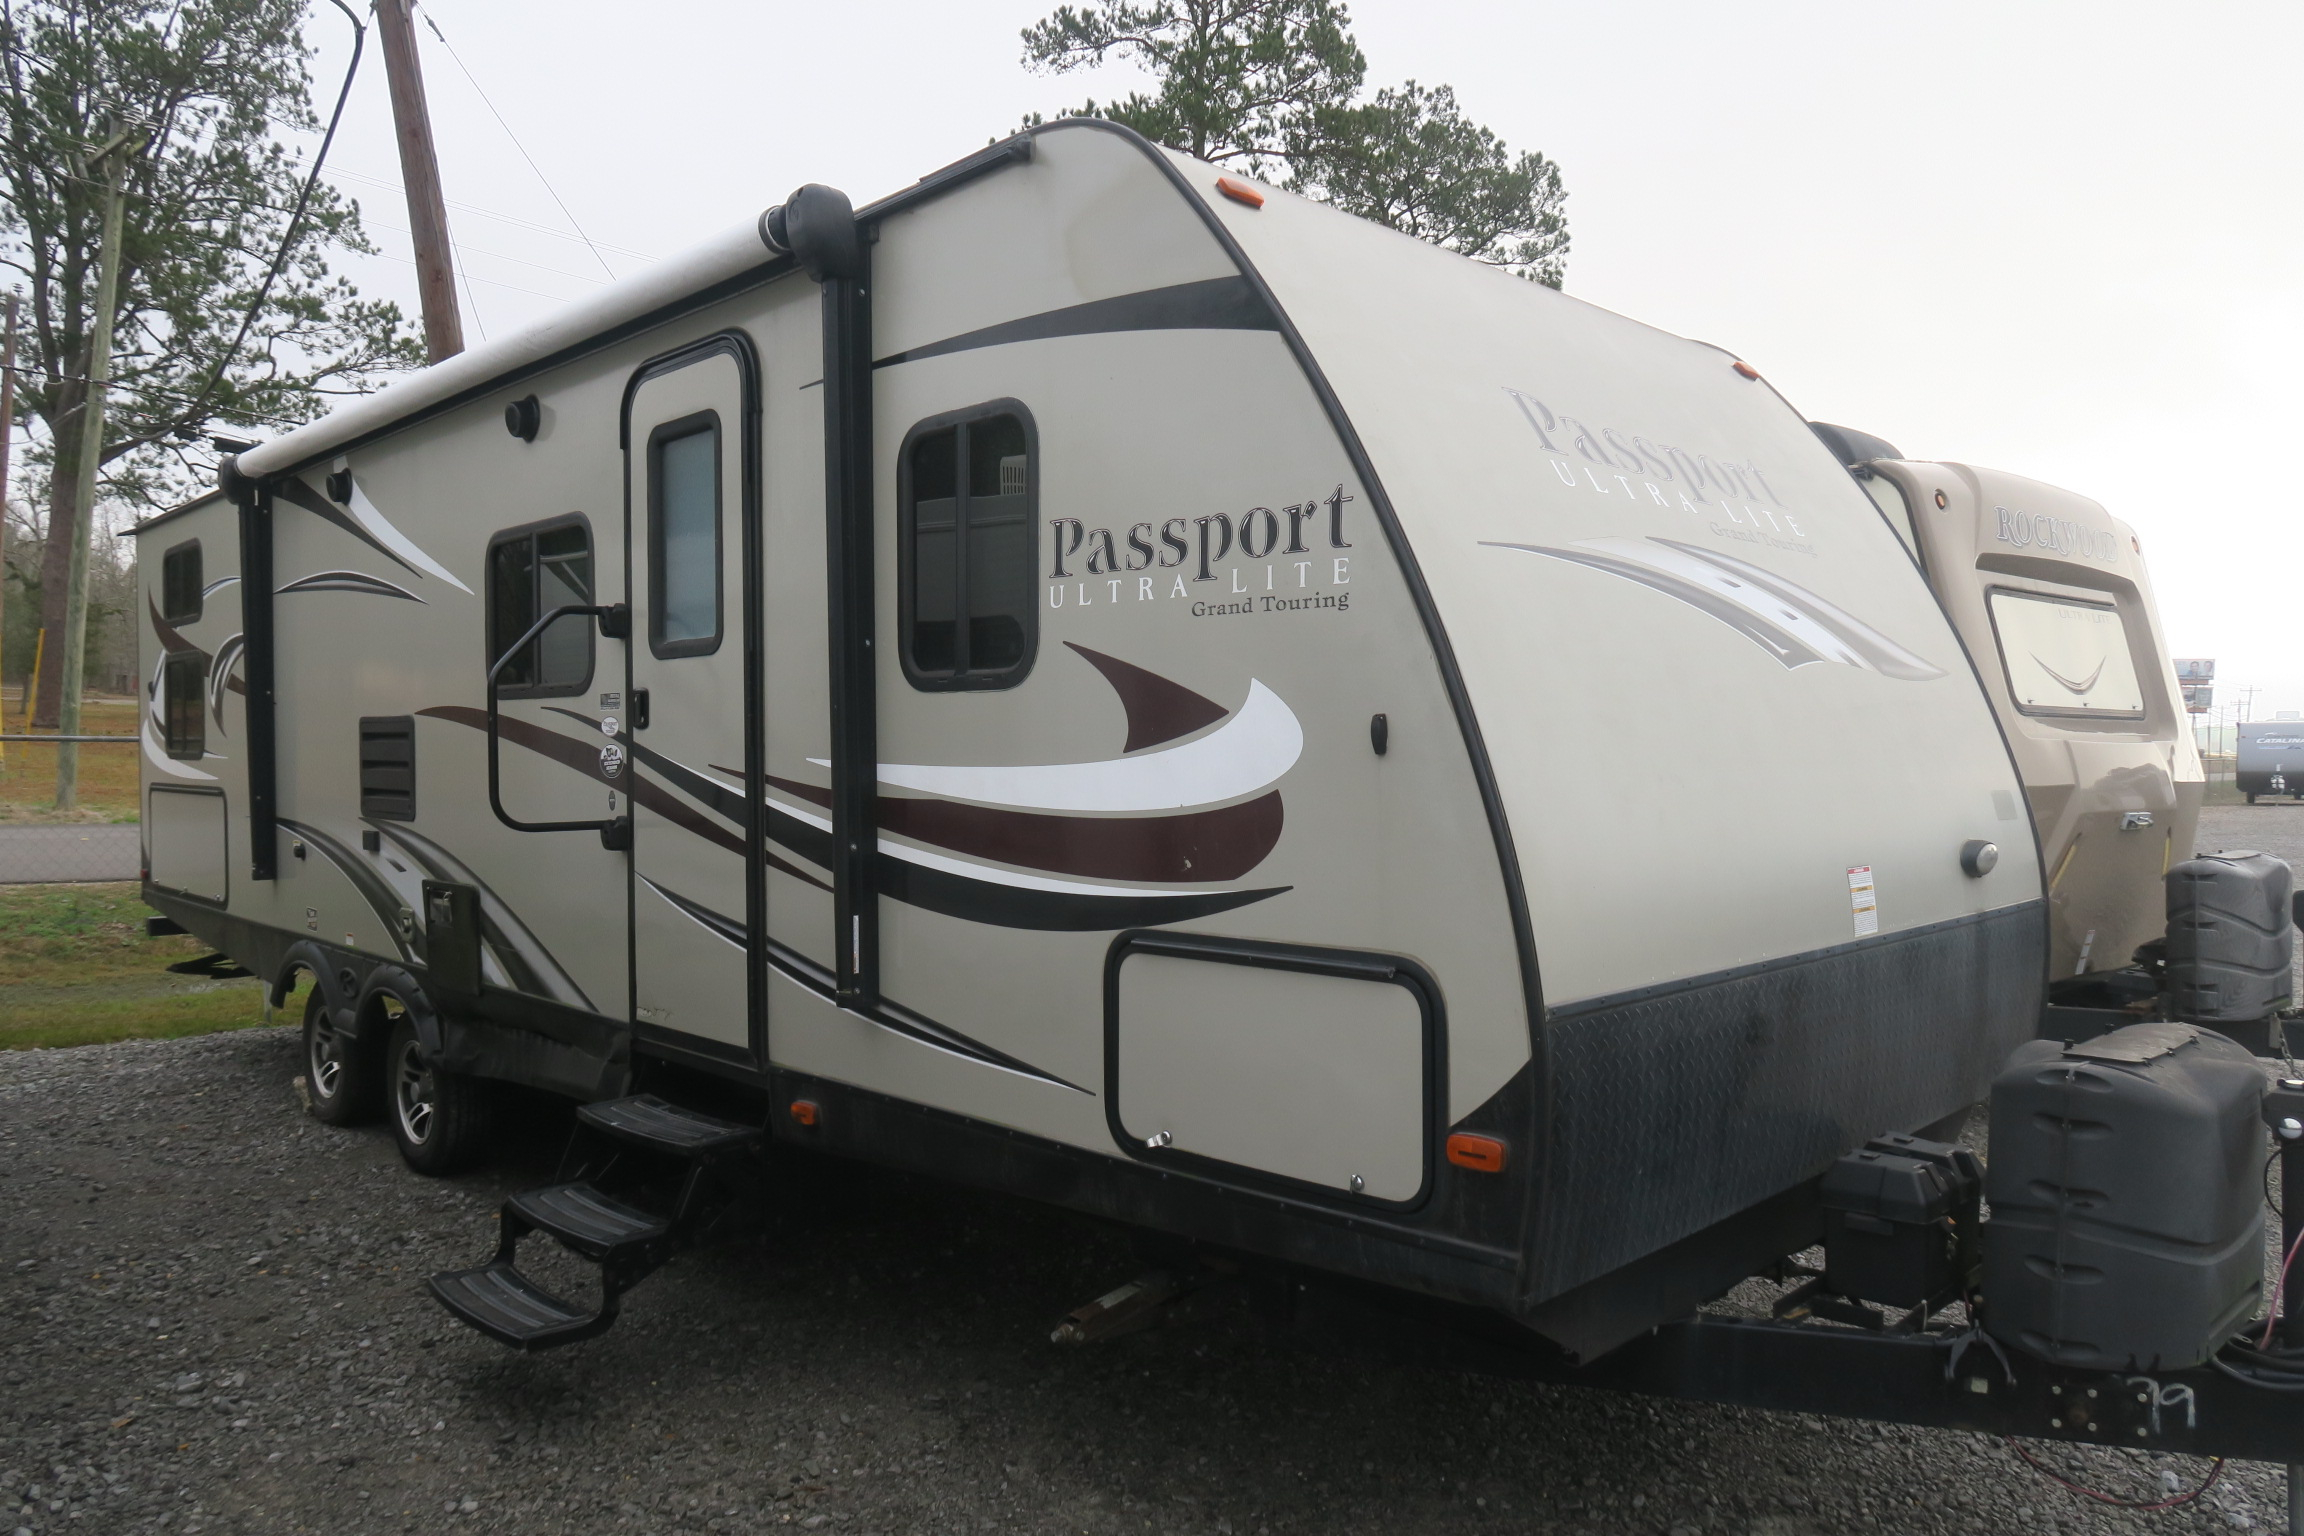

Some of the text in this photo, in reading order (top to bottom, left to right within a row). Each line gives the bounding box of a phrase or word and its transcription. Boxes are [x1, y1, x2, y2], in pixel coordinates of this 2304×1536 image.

[1501, 386, 1788, 509] Passport
[1550, 459, 1804, 536] ULTRA LITE
[1049, 484, 1354, 581] Passport
[1994, 505, 2118, 562] ROCKWOOD
[1050, 557, 1350, 608] ULTRA LITE
[1191, 592, 1350, 617] Grand Touring
